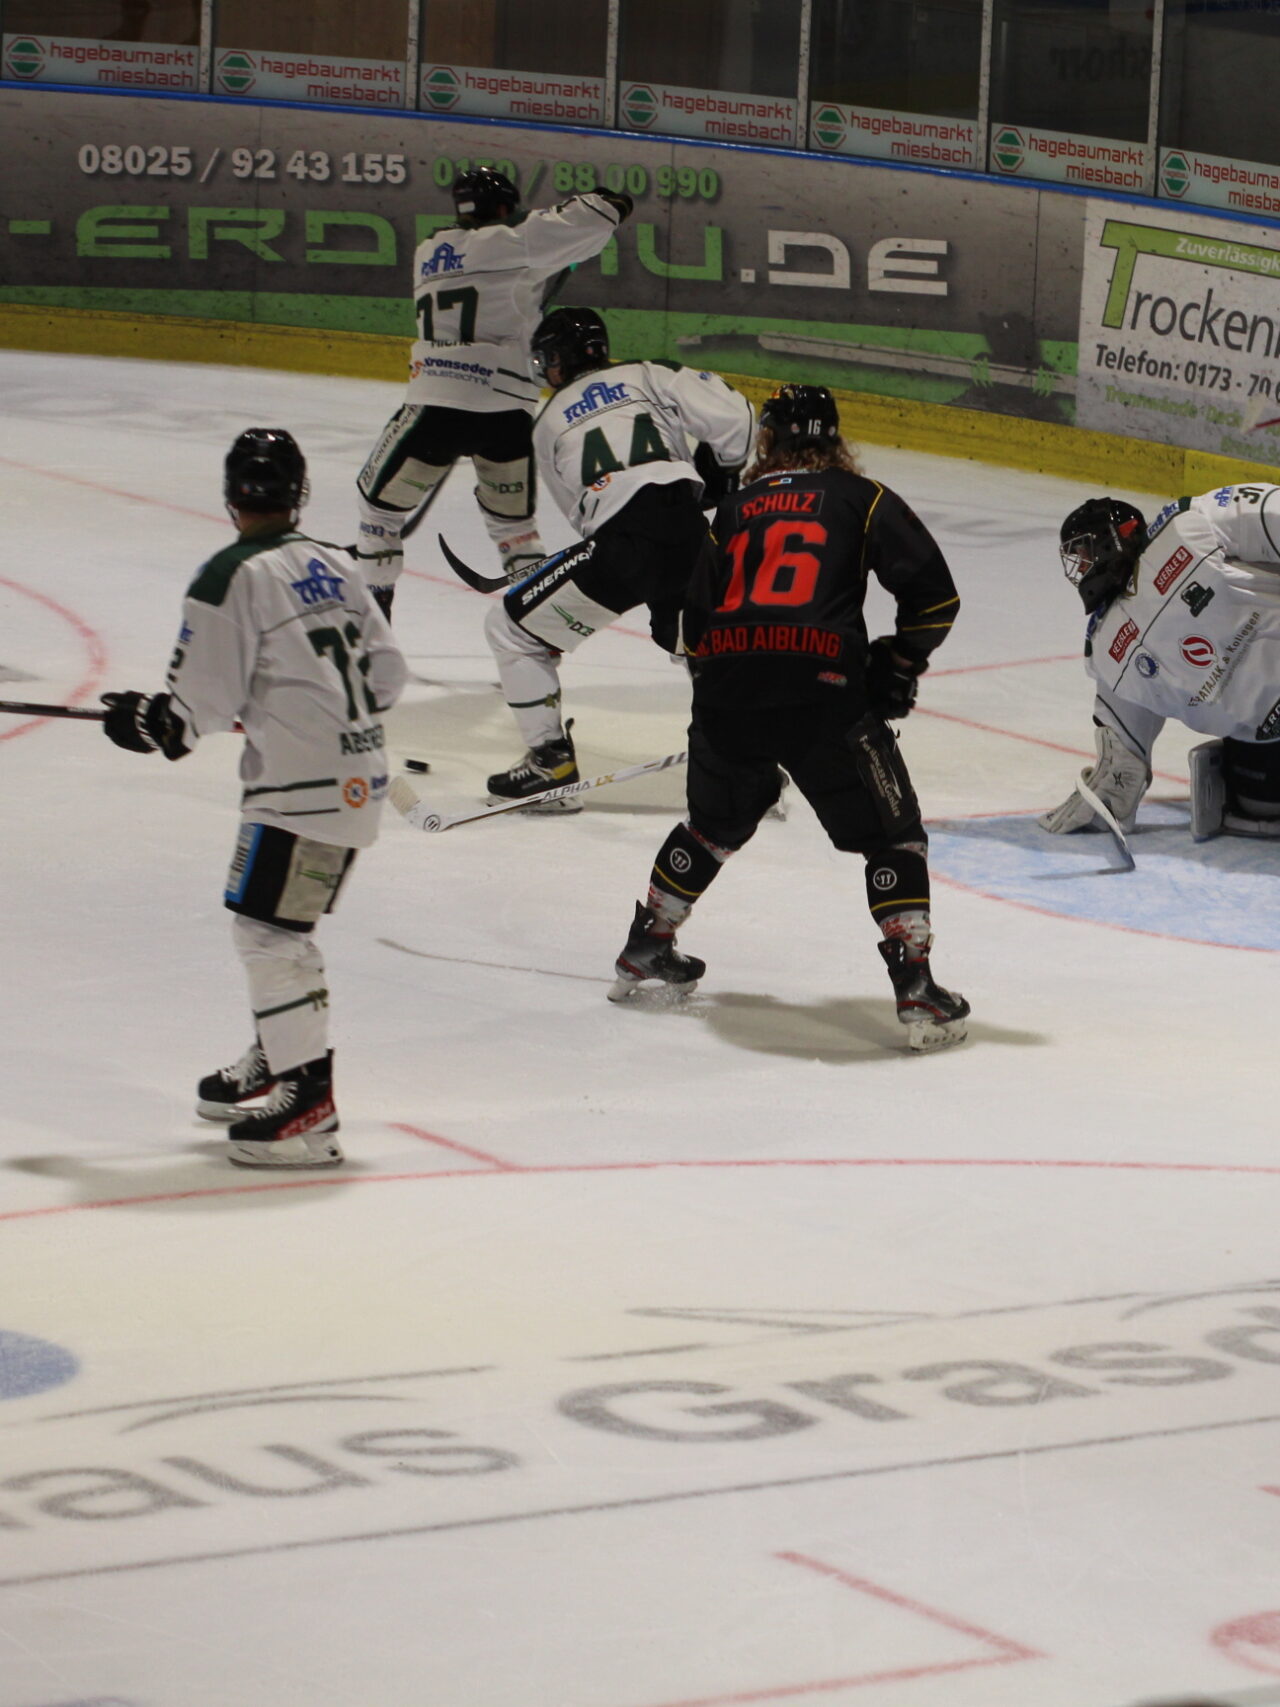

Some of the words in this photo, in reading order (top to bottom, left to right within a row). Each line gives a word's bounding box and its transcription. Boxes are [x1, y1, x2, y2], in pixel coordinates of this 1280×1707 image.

[50, 42, 194, 66] hagebaumarkt
[98, 68, 192, 87] miesbach
[260, 56, 400, 82] hagebaumarkt
[307, 81, 400, 103] miesbach
[465, 71, 601, 99] hagebaumarkt
[510, 98, 599, 121] miesbach
[662, 89, 793, 120] hagebaumarkt
[704, 119, 792, 141] miesbach
[851, 111, 973, 143] hagebaumarkt
[891, 139, 972, 163] miesbach
[1029, 133, 1144, 166] hagebaumarkt
[77, 144, 192, 177] 08025
[200, 147, 221, 183] /
[232, 148, 276, 180] 92
[286, 150, 330, 181] 43
[341, 152, 407, 184] 155
[432, 157, 517, 187] 00
[554, 161, 596, 192] 88
[605, 163, 648, 195] 00
[656, 166, 719, 199] 990
[1066, 163, 1143, 188] miesbach
[8, 205, 948, 297] -ERDU.DE
[417, 286, 479, 342] 17
[1096, 344, 1180, 381] Telefon:
[1184, 360, 1233, 391] 0173
[807, 418, 822, 436] 16
[740, 492, 817, 520] SCHULZ
[714, 519, 829, 614] 16
[711, 625, 749, 653] BAD
[752, 624, 842, 660] AIBLING
[1226, 611, 1261, 653] Kollegen
[543, 780, 591, 801] ALPHA
